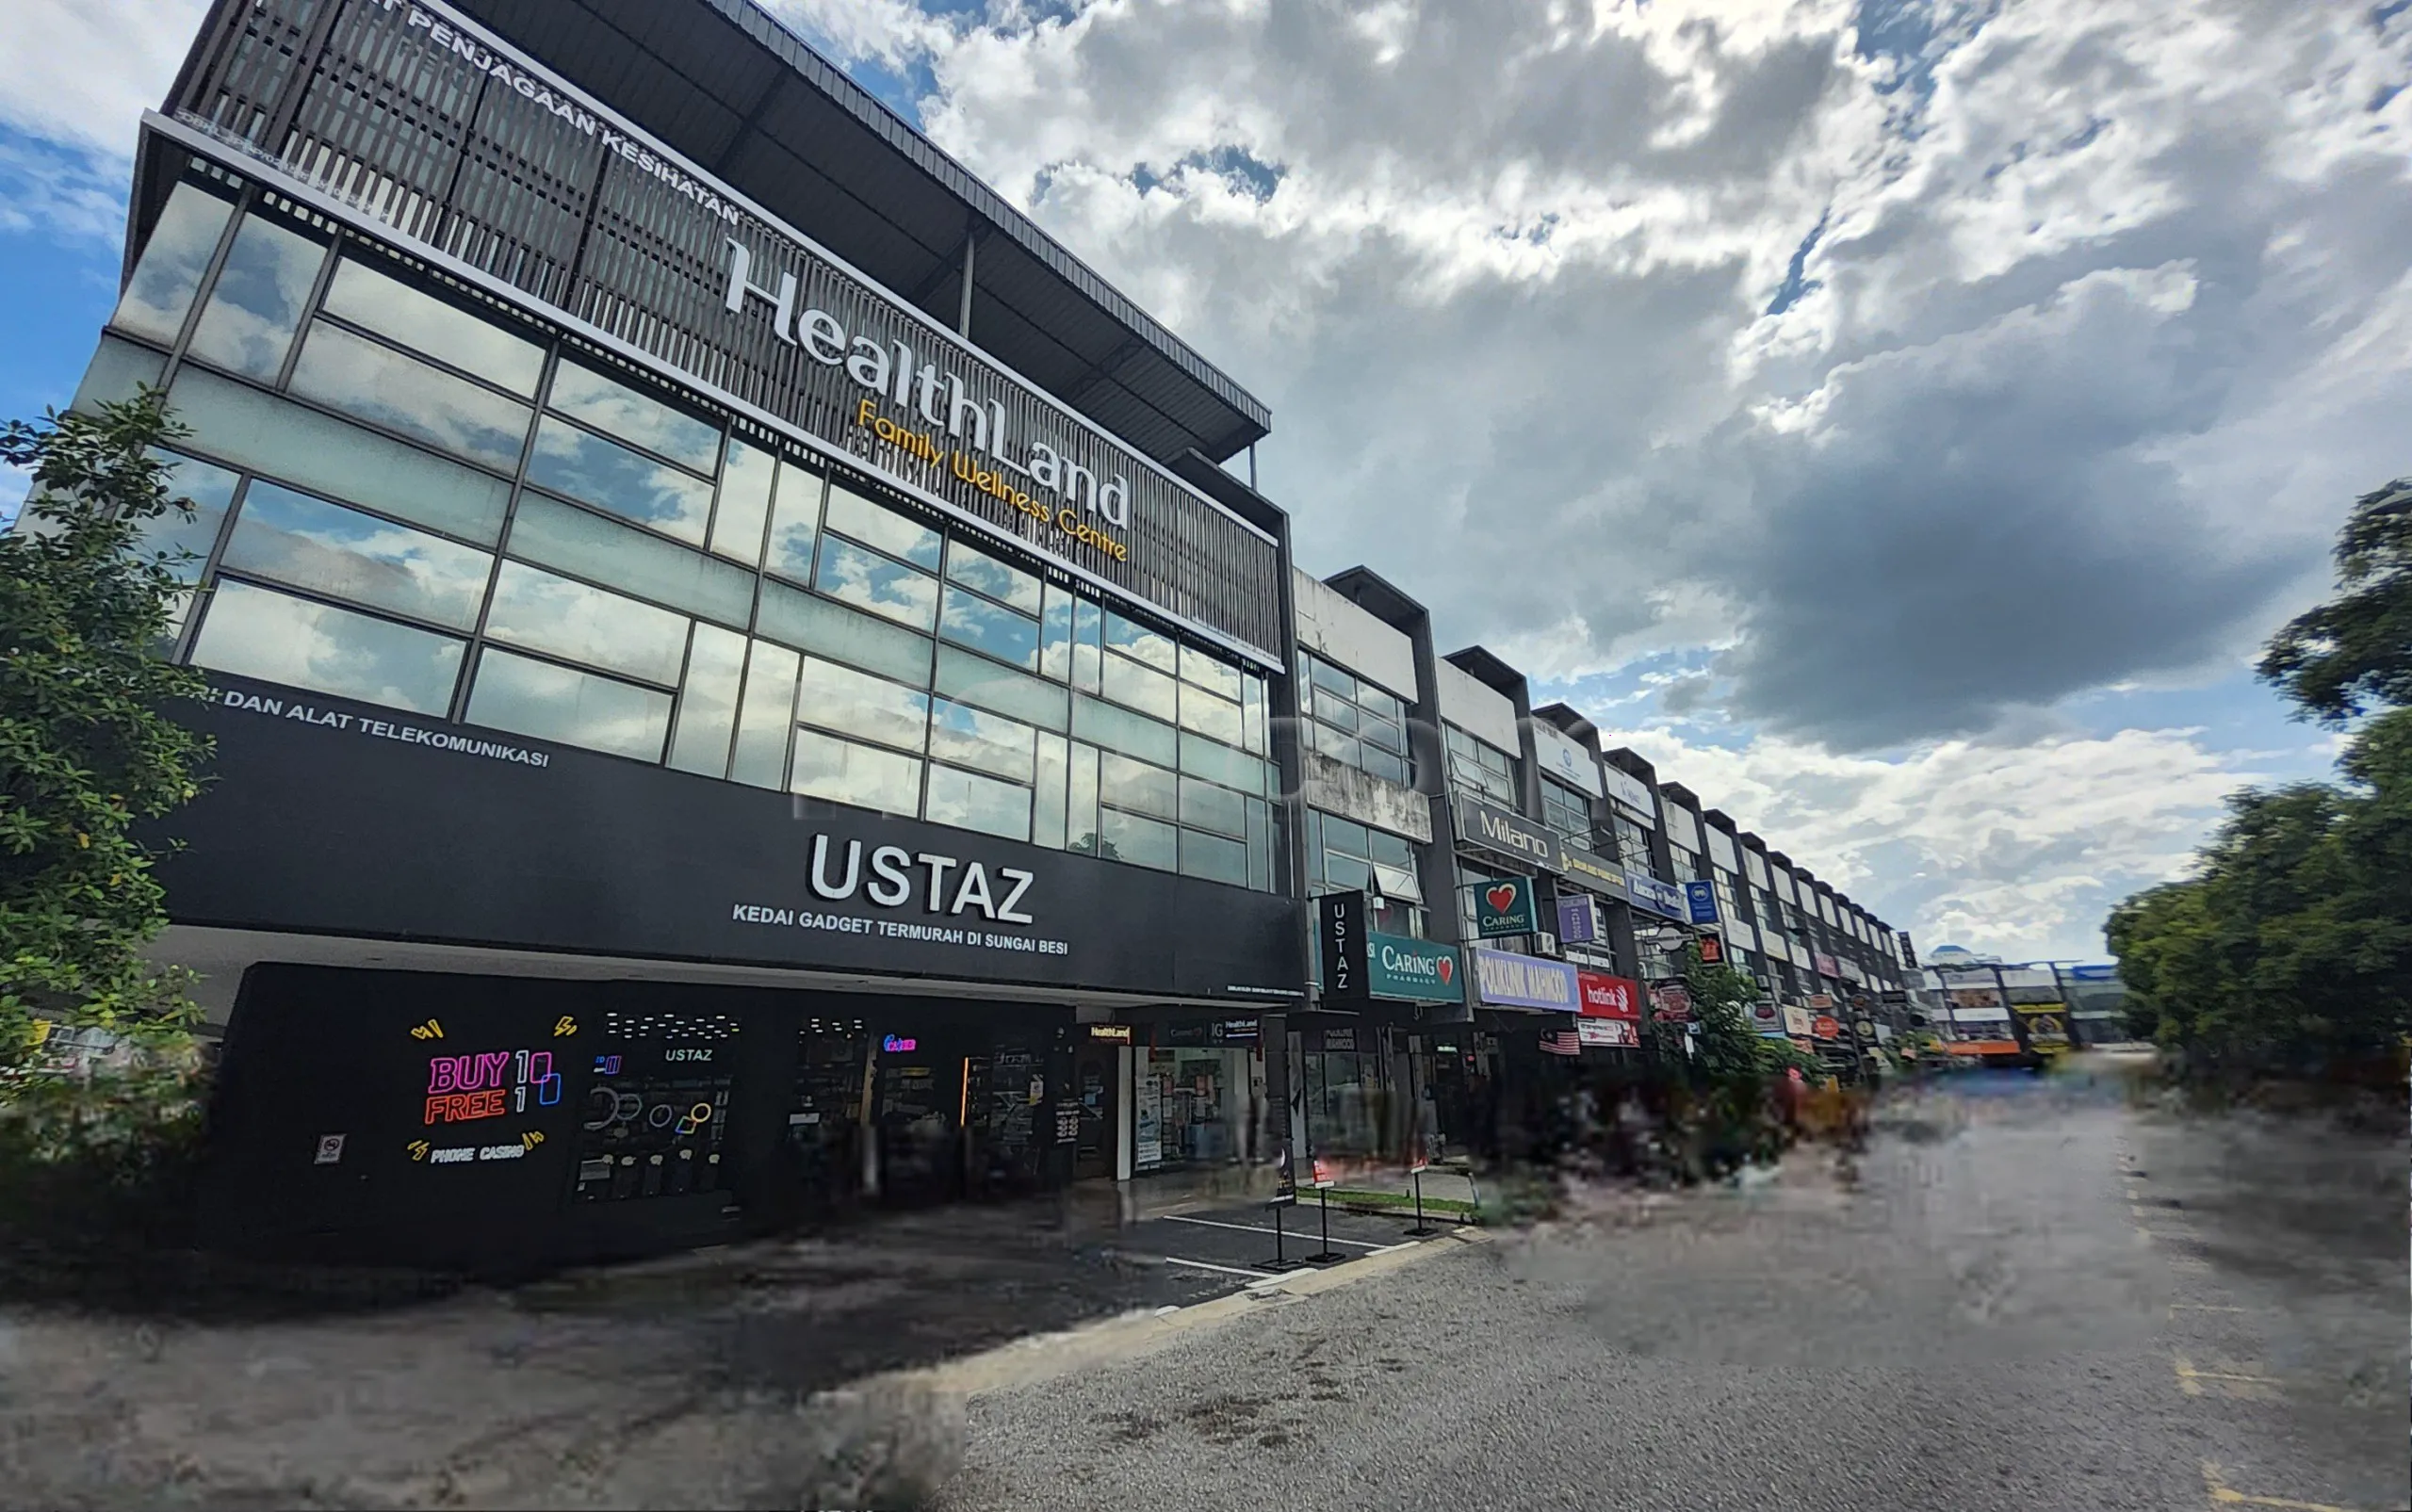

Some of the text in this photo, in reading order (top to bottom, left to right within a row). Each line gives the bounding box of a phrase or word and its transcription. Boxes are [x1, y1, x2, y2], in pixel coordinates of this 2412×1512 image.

[407, 9, 739, 227] PENJAGAAN KESIHATAN
[725, 236, 1128, 530] HealthLand
[858, 399, 1128, 562] Family Wellness Centre
[222, 690, 550, 768] DAN ALAT TELEKOMUNIKASI
[1479, 810, 1548, 858] Milano
[811, 834, 1034, 924] USTAZ
[732, 903, 1068, 954] KEDAI GADGET TERMURAH DI SUNGAI BESI
[1482, 914, 1524, 927] CARING
[1333, 902, 1349, 989] USTAZ
[1587, 984, 1618, 1007] hotlink
[428, 1051, 510, 1094] BUY
[665, 1049, 713, 1062] USTAZ
[424, 1086, 527, 1125] FREE 1
[430, 1146, 476, 1163] PHONE
